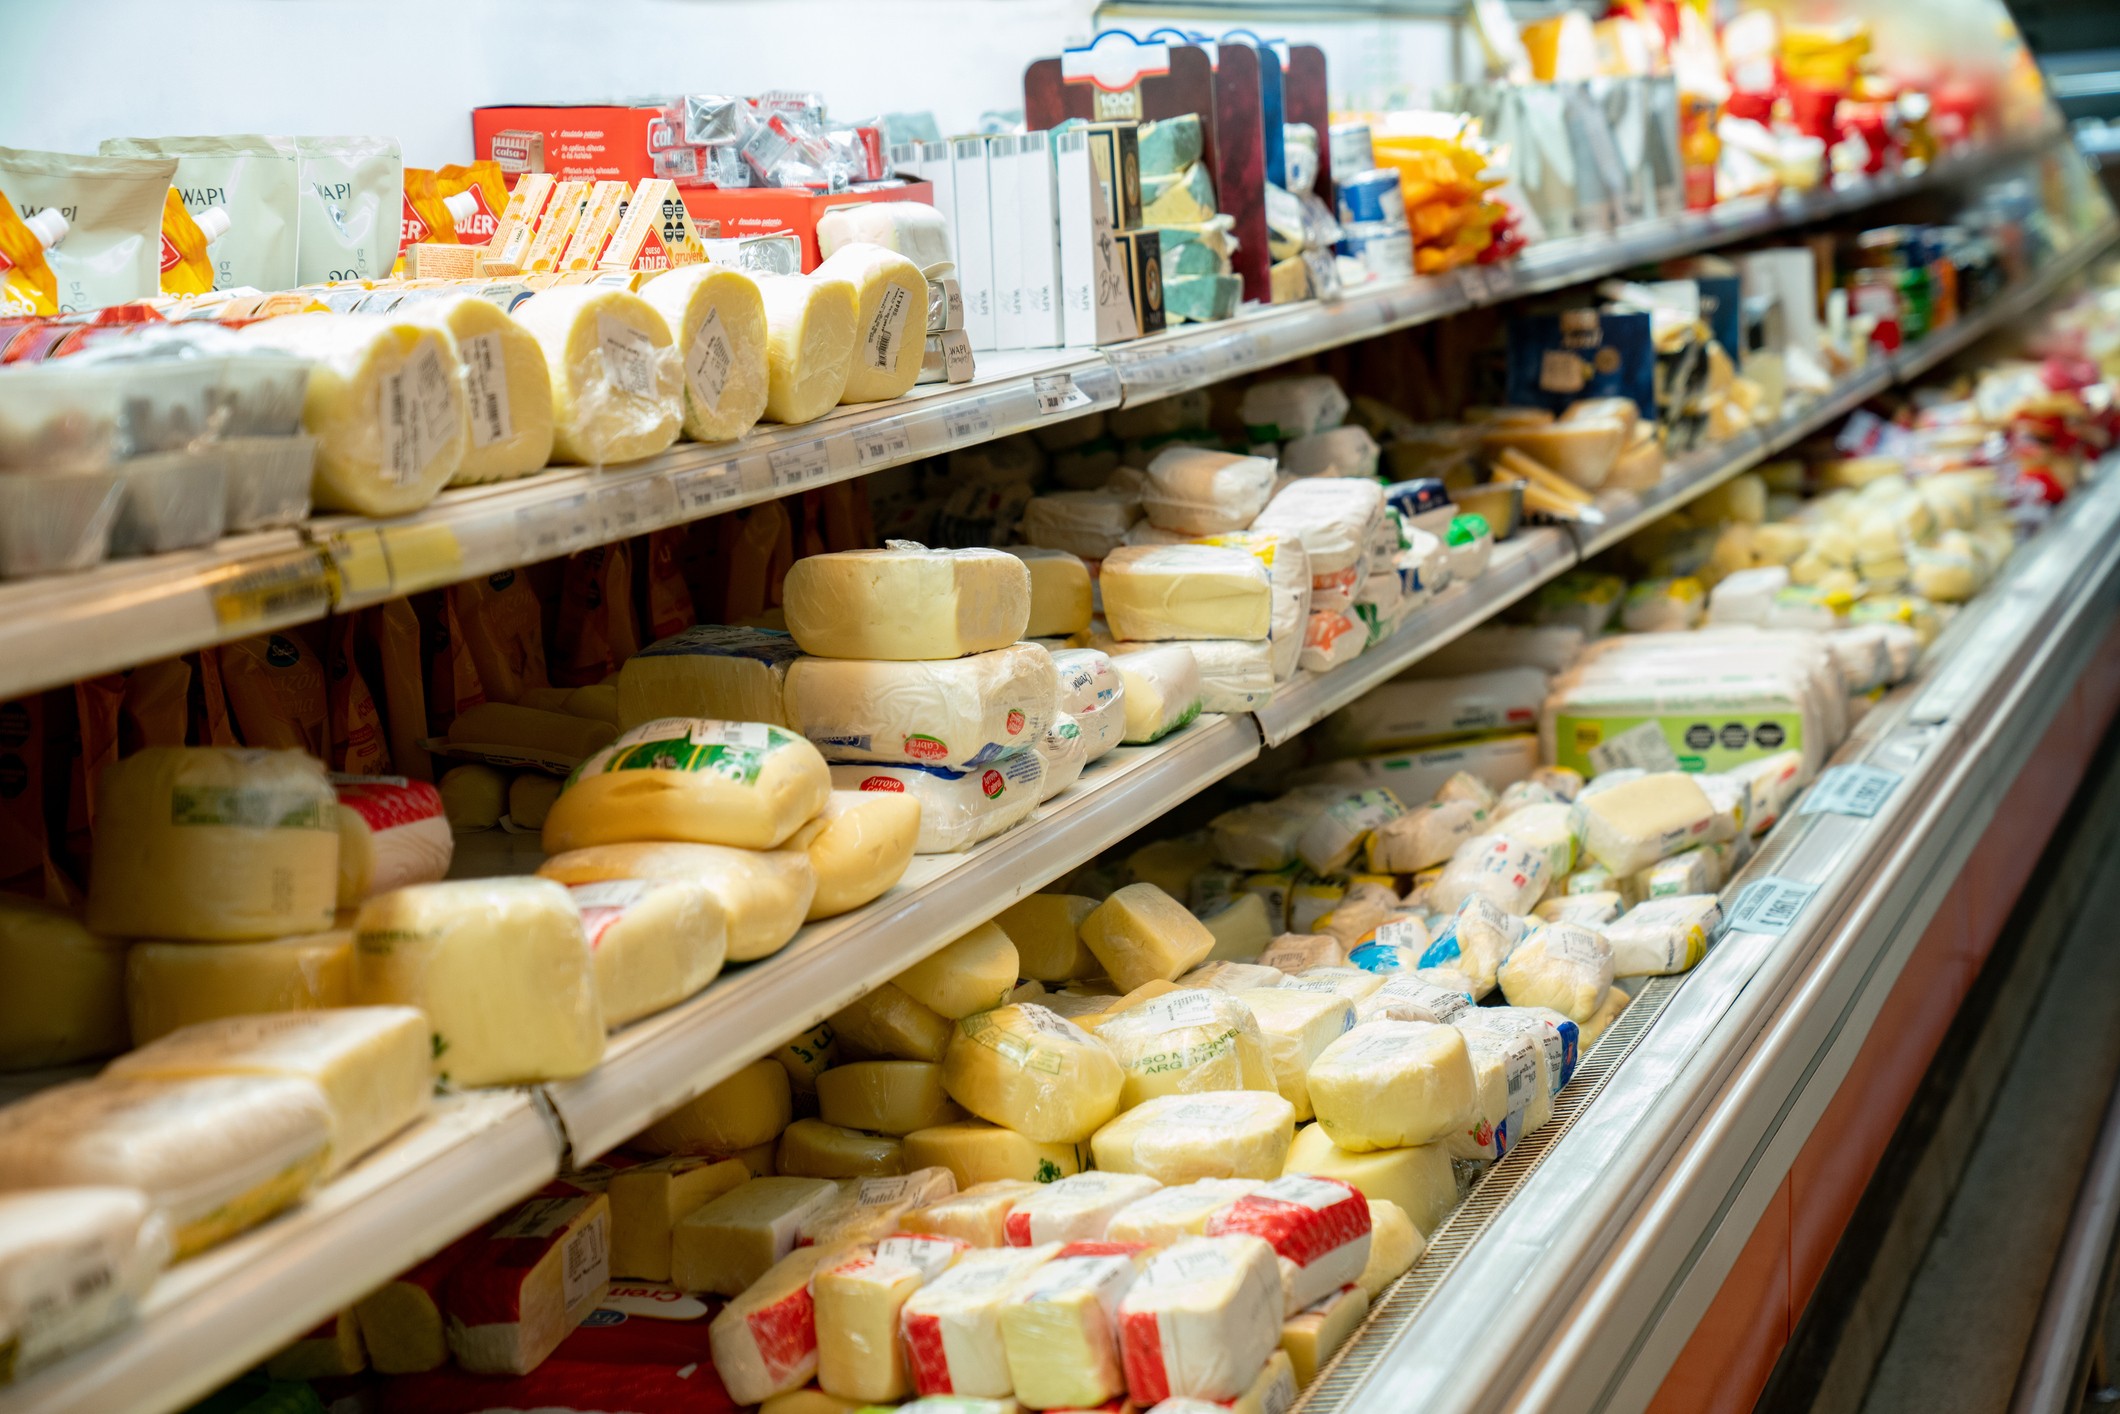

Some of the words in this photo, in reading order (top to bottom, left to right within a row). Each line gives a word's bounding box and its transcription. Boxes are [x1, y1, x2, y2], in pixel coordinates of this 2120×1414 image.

[495, 147, 520, 158] calsa
[176, 187, 227, 206] WAPI
[313, 182, 351, 200] WAPI
[20, 204, 78, 223] WPI
[644, 246, 661, 256] QUESO
[675, 251, 704, 266] gruyère
[638, 256, 667, 271] ADLER
[948, 344, 967, 356] WAPI
[868, 776, 902, 789] Arroyo
